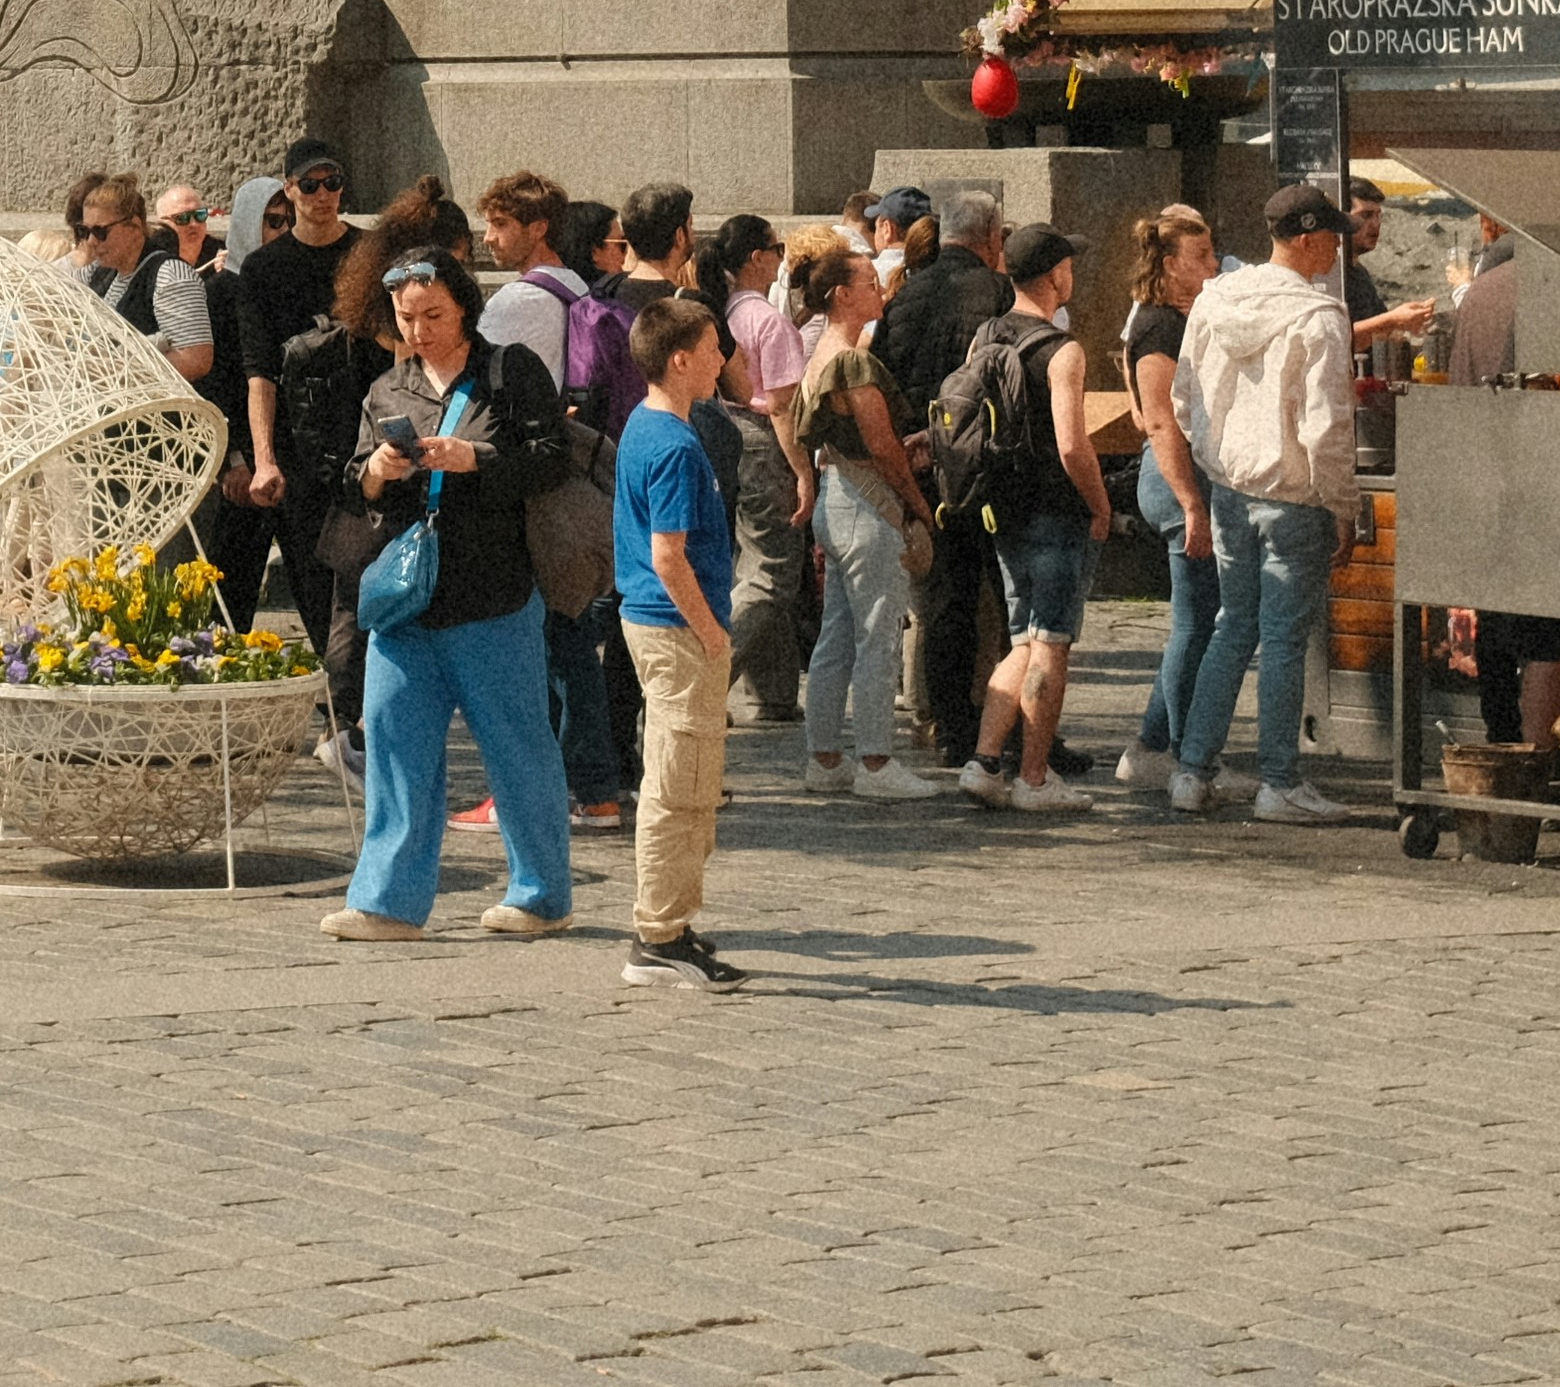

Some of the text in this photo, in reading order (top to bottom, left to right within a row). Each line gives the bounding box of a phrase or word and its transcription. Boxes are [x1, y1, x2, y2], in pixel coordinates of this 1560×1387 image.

[1328, 26, 1524, 55] OLD PRAGUE HAM
